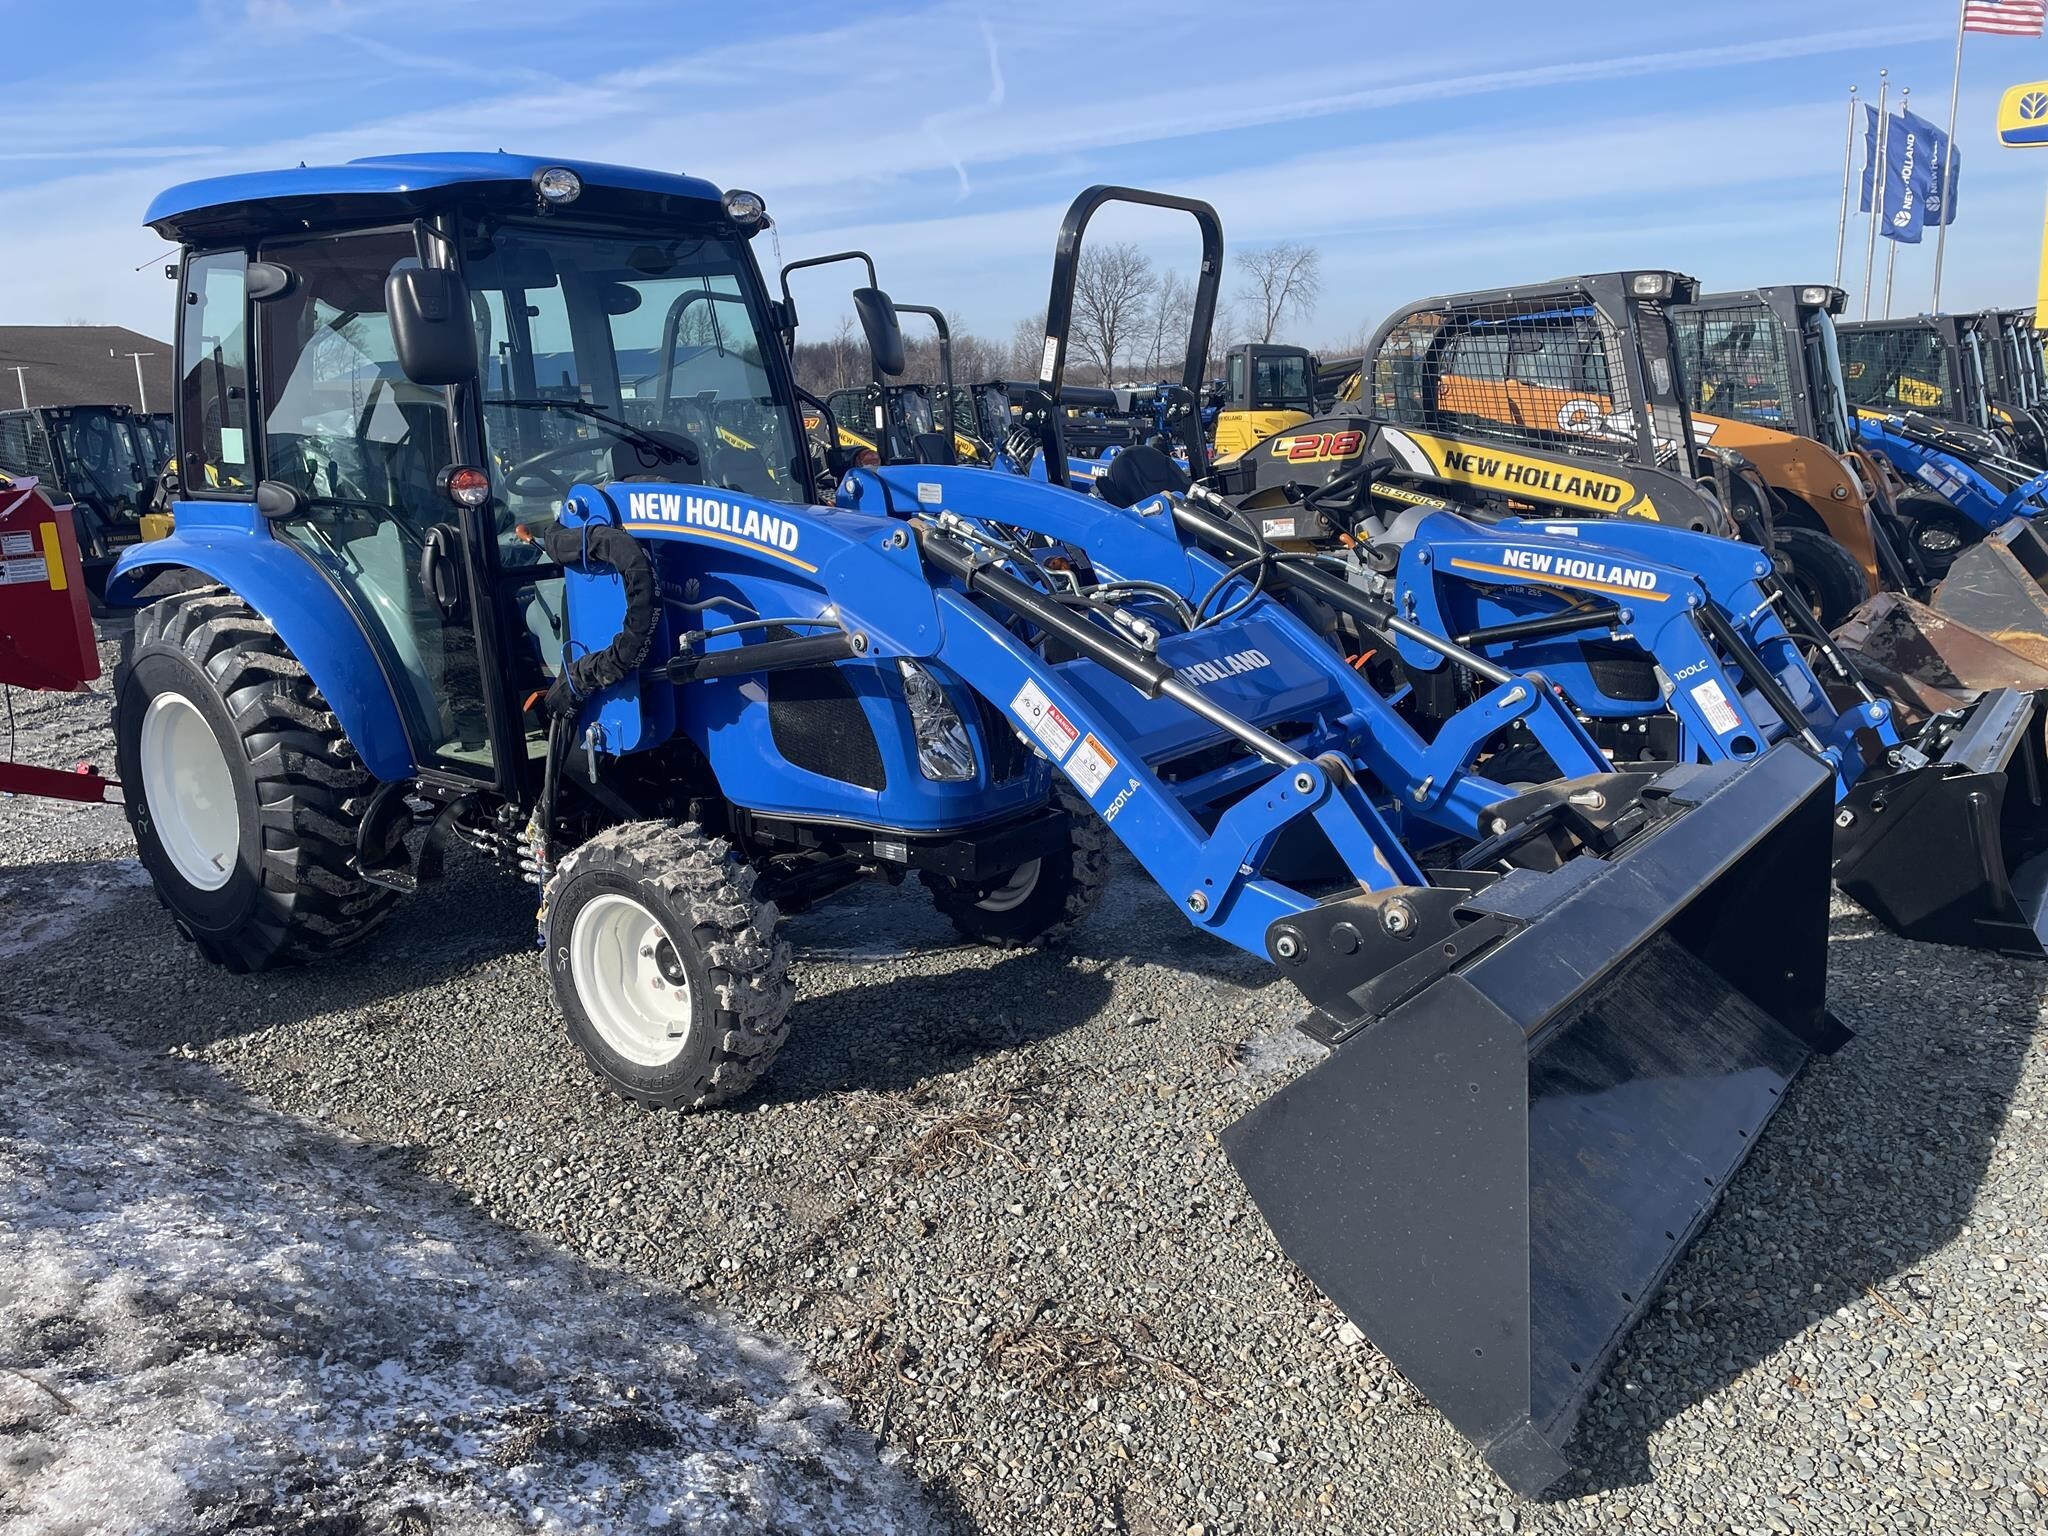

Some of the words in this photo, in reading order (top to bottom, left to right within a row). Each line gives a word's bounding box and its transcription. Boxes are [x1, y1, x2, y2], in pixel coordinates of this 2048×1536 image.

[1901, 384, 1935, 401] NEW
[1444, 449, 1501, 478] NEW
[1504, 462, 1622, 504] HOLLAND
[1391, 489, 1446, 509] SERIES
[629, 491, 681, 522] NEW
[686, 495, 799, 552] HOLLAND
[1502, 548, 1552, 573] NEW
[1554, 556, 1657, 591] HOLLAND
[1178, 648, 1271, 686] HOLLAND
[1673, 659, 1709, 682] 100LC
[1053, 712, 1078, 740] DANGER
[1102, 777, 1142, 823] 250TLA
